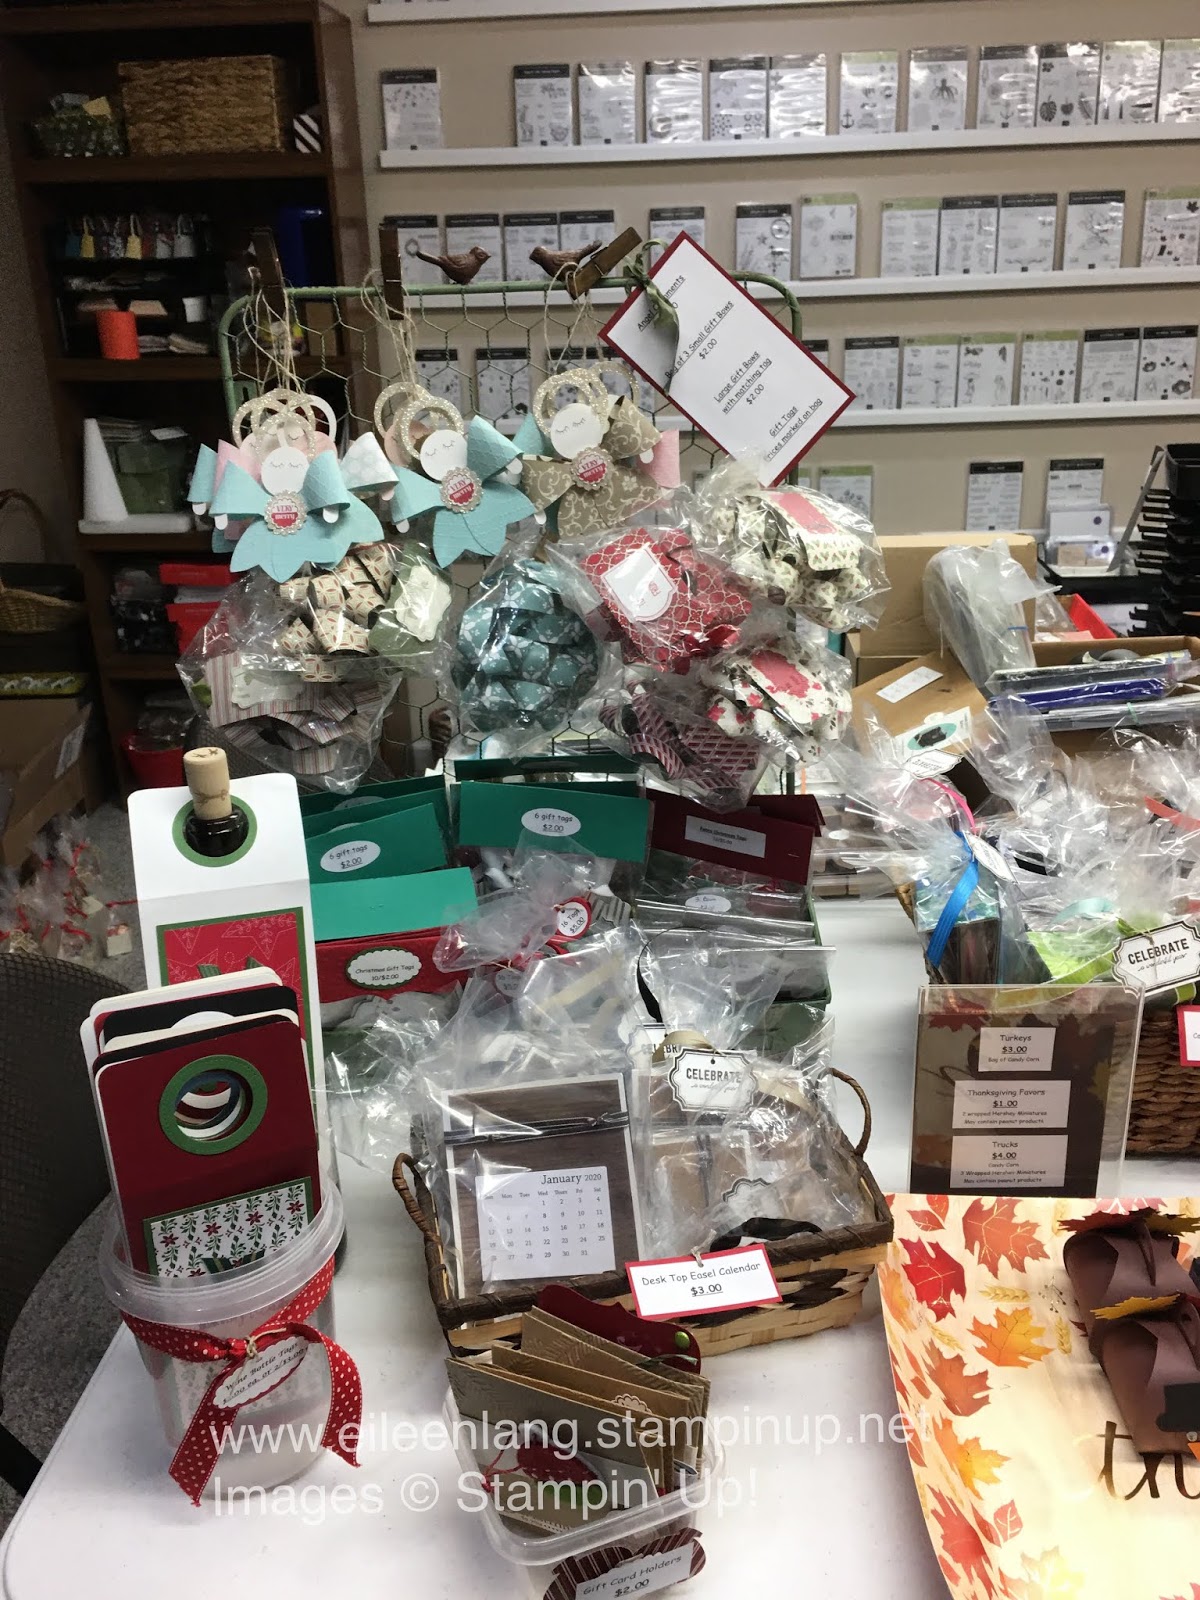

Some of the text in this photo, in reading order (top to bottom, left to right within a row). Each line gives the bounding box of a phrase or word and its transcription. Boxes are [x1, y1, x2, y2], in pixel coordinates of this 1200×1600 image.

[637, 275, 685, 331] Angel Oments
[677, 355, 685, 367] of
[683, 350, 690, 358] 3
[689, 331, 705, 352] Small
[704, 317, 718, 334] Gift
[716, 301, 734, 319] Bows
[699, 338, 718, 360] $2.00
[714, 351, 760, 402] Large Gift Bows
[722, 358, 772, 414] with matching tag
[746, 384, 765, 405] $2.00
[769, 406, 798, 437] Gift Tags
[781, 418, 804, 442] marked
[803, 409, 811, 421] on
[809, 398, 823, 412] bag
[543, 824, 564, 832] $2.00
[336, 849, 350, 859] gift
[352, 844, 368, 853] tags
[341, 857, 362, 869] $2.00
[570, 917, 585, 934] $5.00
[1127, 938, 1190, 965] CELEBRATE
[1000, 1034, 1032, 1042] Turkeys
[1002, 1046, 1027, 1054] $3.00
[686, 1067, 741, 1083] CELEBRATE
[967, 1088, 1046, 1097] Thanksgiving Favors
[993, 1100, 1018, 1108] $1.00
[992, 1152, 1017, 1160] $4.00
[541, 1173, 602, 1185] January 2020
[641, 1262, 761, 1286] Desk Top Easel Calendar
[691, 1283, 723, 1296] $3.00
[250, 1356, 276, 1375] Bottle
[222, 1386, 246, 1405] $.00
[262, 1370, 272, 1378] or
[583, 1556, 682, 1595] Gift Card Holders
[614, 1579, 650, 1598] $2.00
